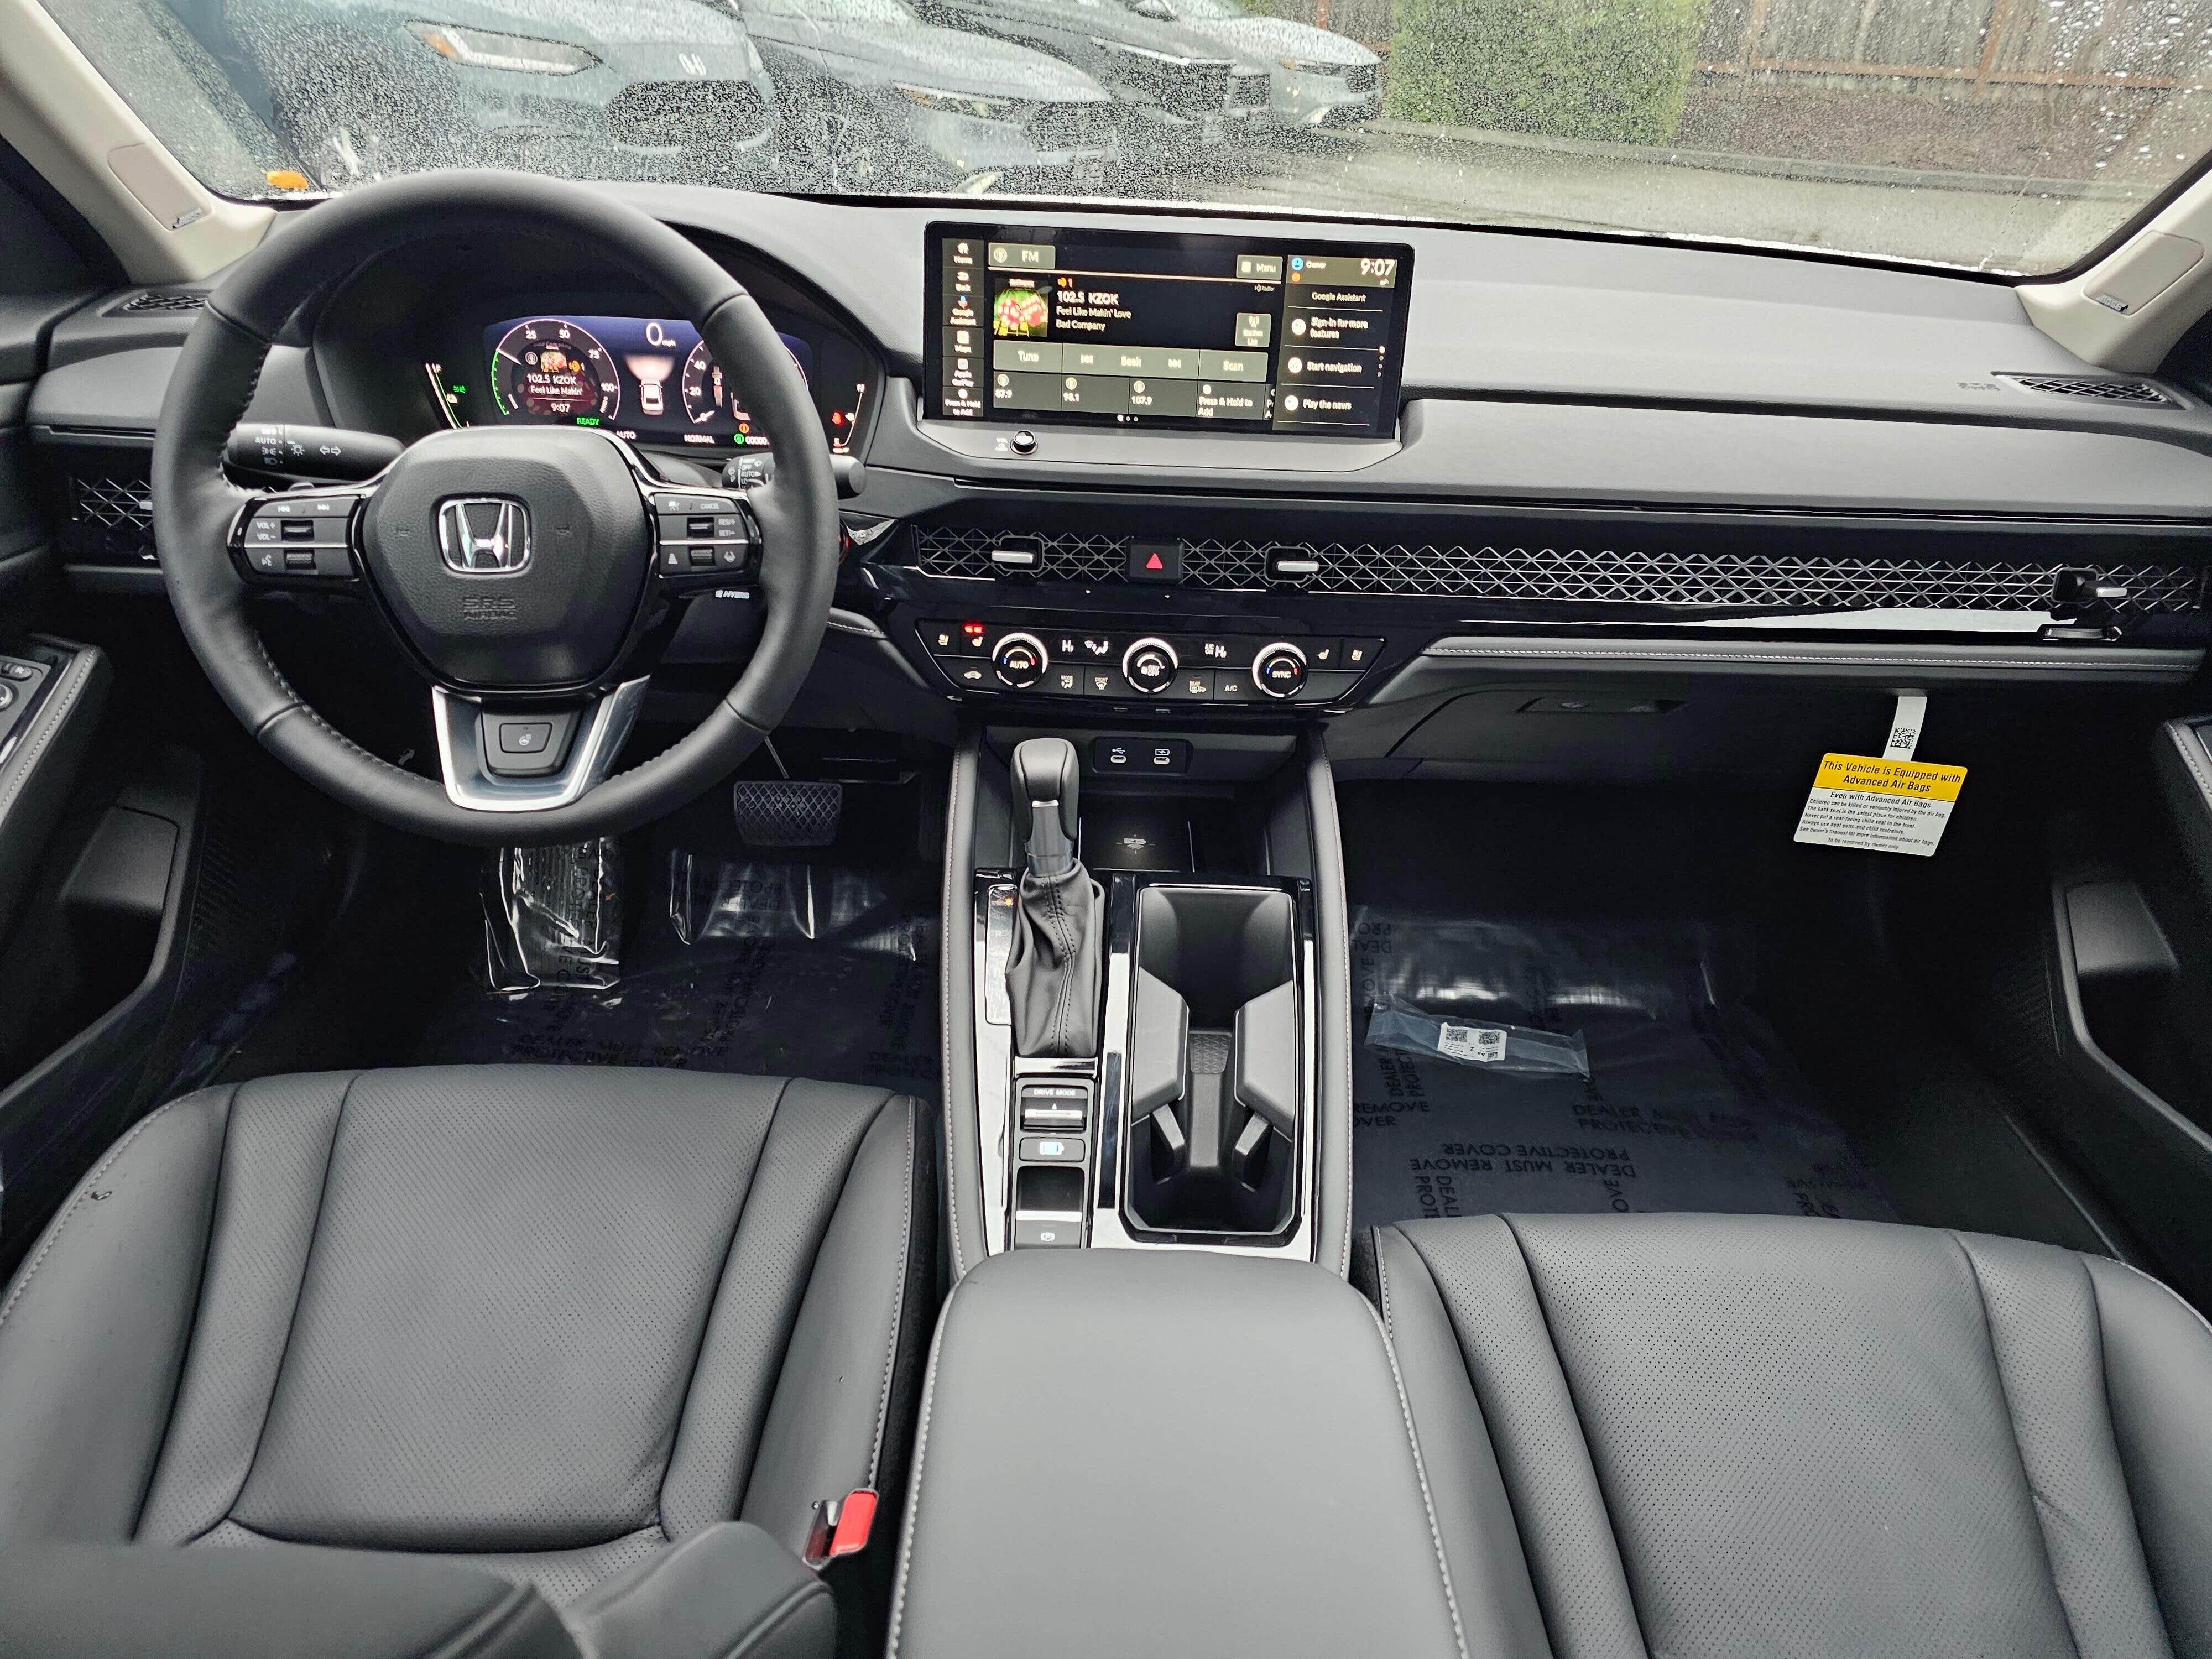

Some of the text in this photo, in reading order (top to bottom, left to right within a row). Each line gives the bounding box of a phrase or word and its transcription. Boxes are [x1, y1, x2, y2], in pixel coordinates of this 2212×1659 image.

[1022, 251, 1039, 262] FM
[1256, 263, 1276, 273] Menu
[1306, 261, 1326, 269] Owner
[1360, 258, 1395, 276] 9:07
[1057, 291, 1119, 305] 102.5 KZOK
[1312, 292, 1366, 302] Google Assistant
[1056, 306, 1131, 318] Feel Like Makin' Love
[1056, 319, 1105, 332] Bad Company
[1337, 318, 1349, 328] for
[526, 330, 536, 340] 25
[559, 330, 570, 339] 50
[646, 322, 662, 346] 0
[1310, 329, 1339, 339] features
[588, 349, 600, 359] 75
[1018, 351, 1039, 362] Tune
[693, 361, 706, 371] 40
[1120, 356, 1141, 367] Seek
[1223, 361, 1244, 371] Scan
[1307, 361, 1362, 374] Start navigation
[526, 373, 577, 385] 102.5 KZOK
[531, 385, 546, 394] Feel
[601, 383, 615, 392] 100
[689, 386, 701, 396] 20
[1198, 397, 1253, 407] Press & Hold to
[1303, 399, 1352, 410] Play the news
[551, 403, 570, 413] 9:07
[1197, 407, 1213, 416] Add
[255, 435, 276, 445] AUTO
[616, 431, 636, 439] AUTO
[684, 434, 714, 444] NORMAL
[1824, 761, 1961, 783] This Vehicle is Equipped with
[1843, 775, 1931, 792] Advanced Air Bags
[1865, 795, 1900, 805] Advanced
[1914, 800, 1931, 808] Bags
[1870, 833, 1898, 841] information
[1353, 1115, 1397, 1128] OVER
[1441, 1143, 1631, 1161] PROTECTIVE COVER
[1410, 1157, 1636, 1178] DEALER MUST REMOVE
